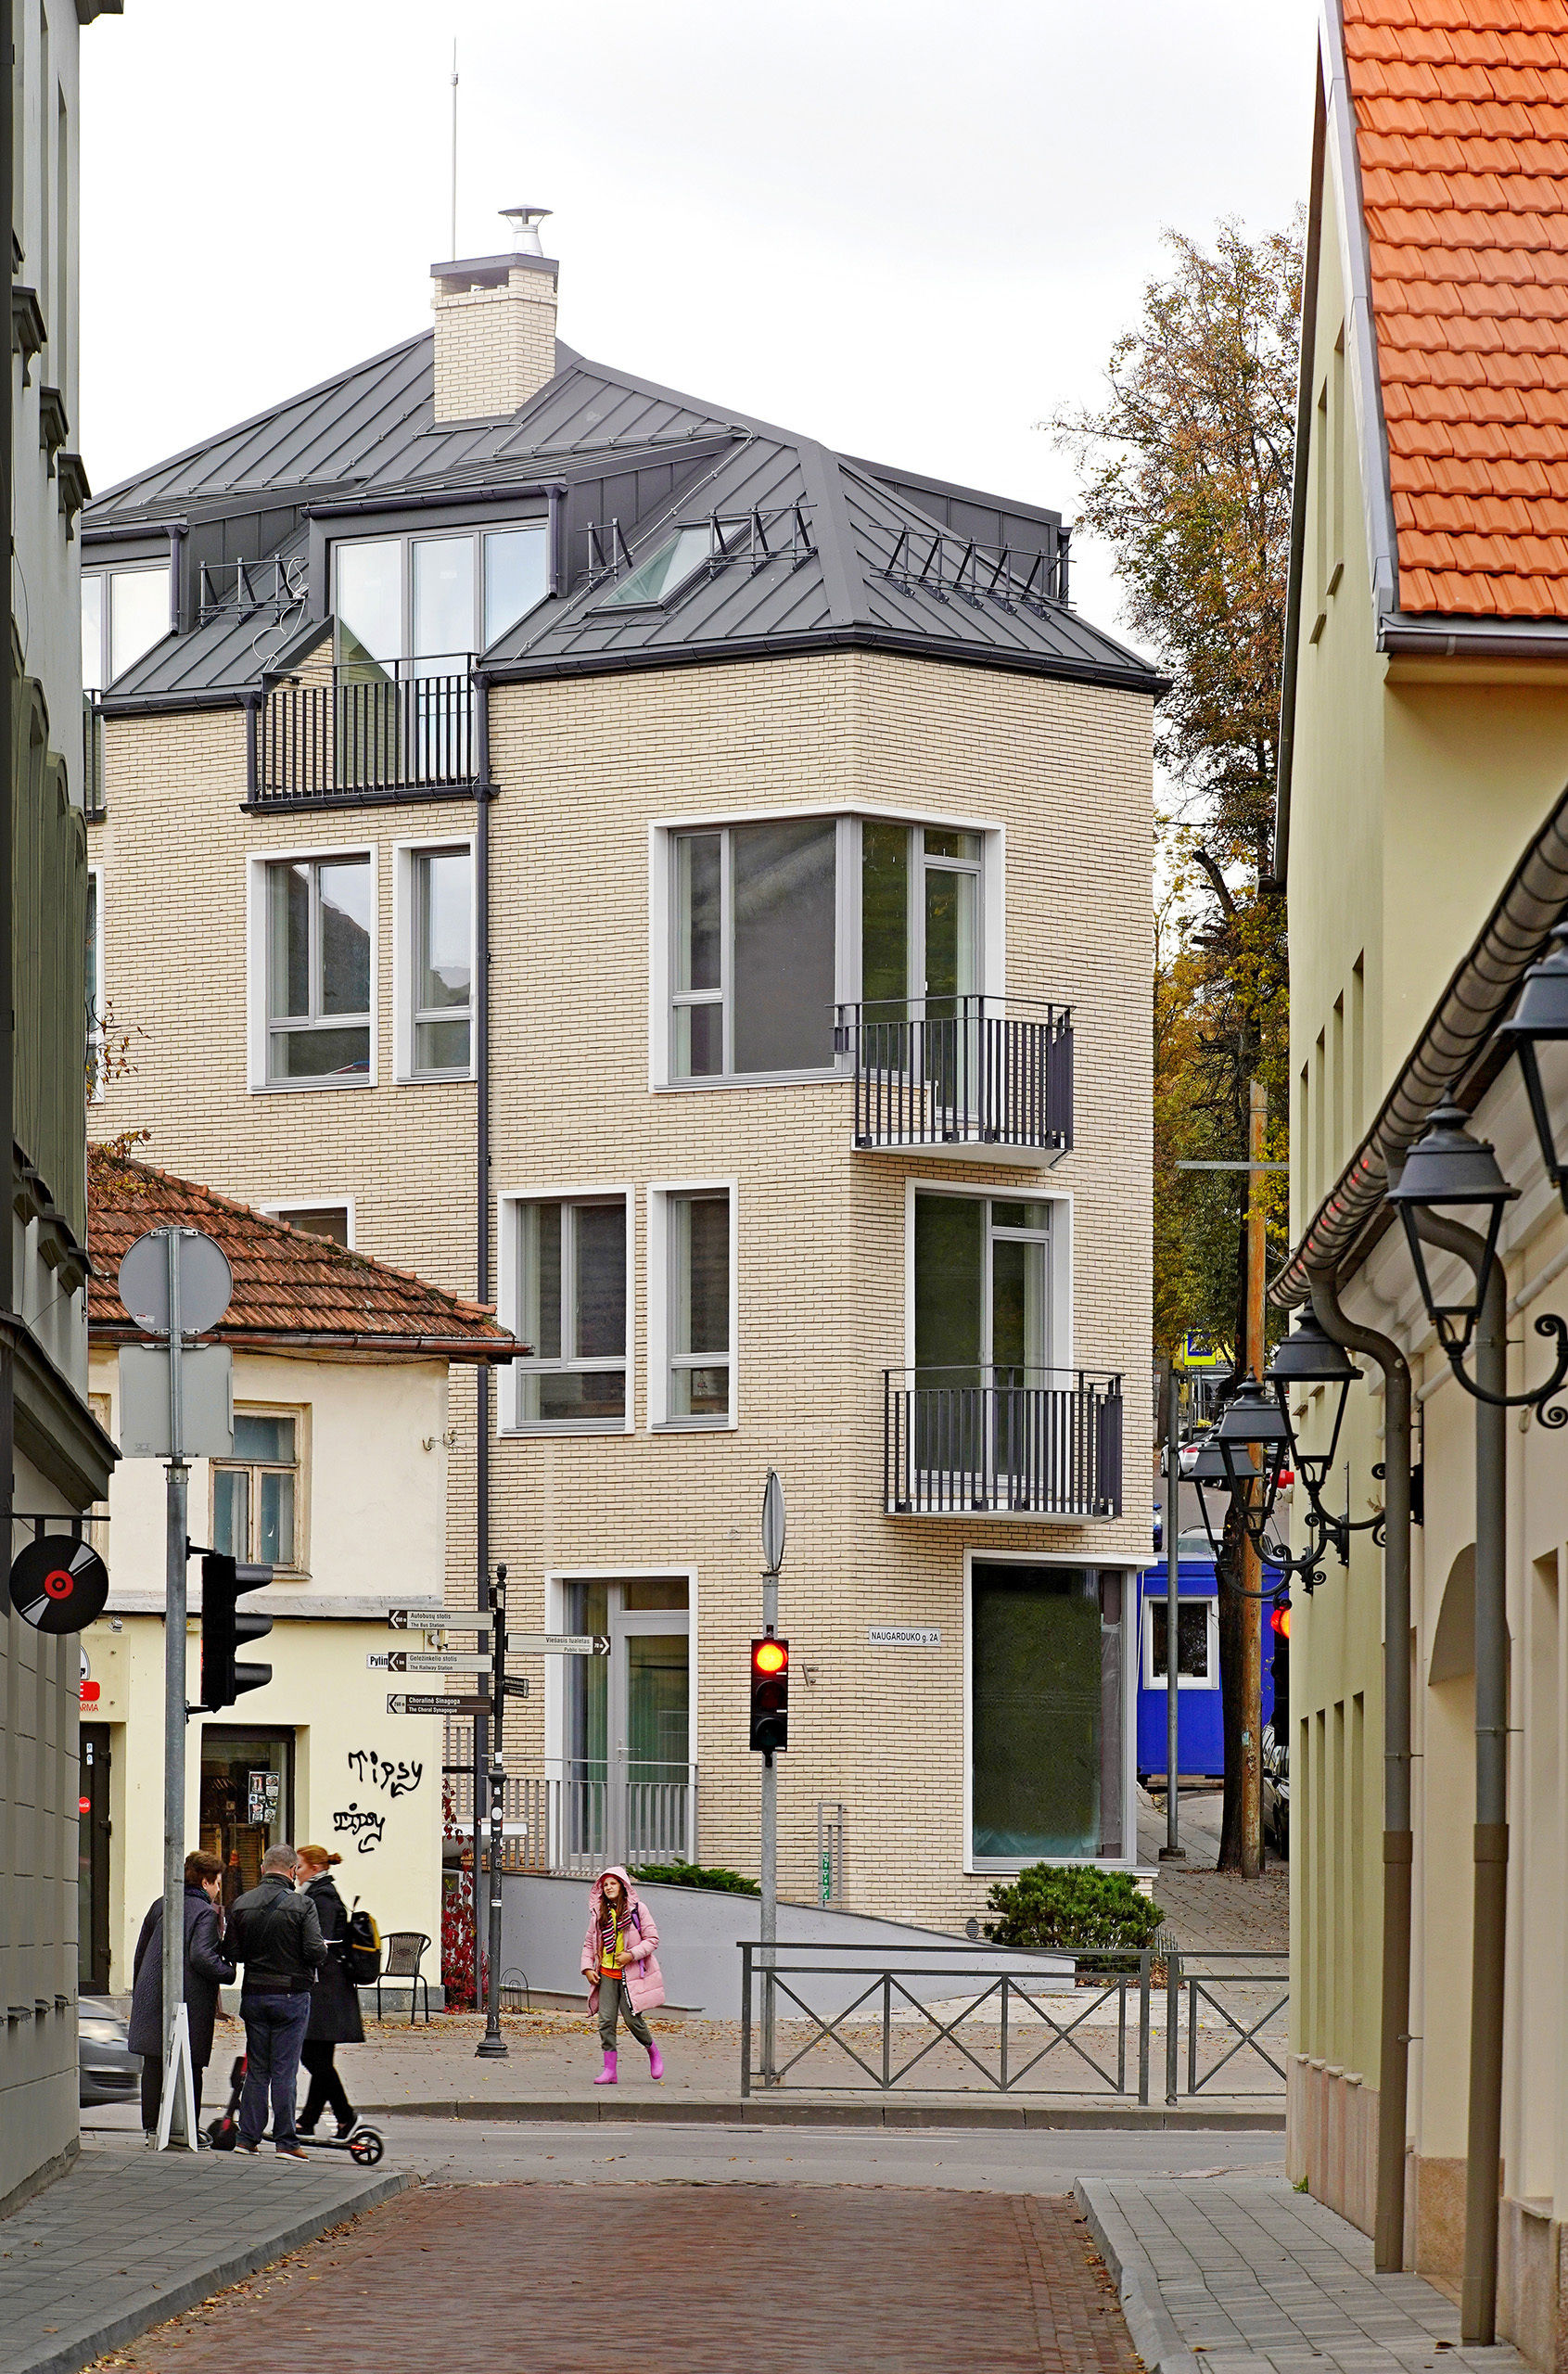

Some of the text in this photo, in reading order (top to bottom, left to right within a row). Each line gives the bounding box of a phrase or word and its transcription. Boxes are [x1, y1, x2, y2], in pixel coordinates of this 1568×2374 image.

[871, 1631, 938, 1643] NAUGARDUKO g. 2A
[409, 1654, 442, 1663] Geležinkelio
[408, 1696, 461, 1705] Choralinė Sinagoga
